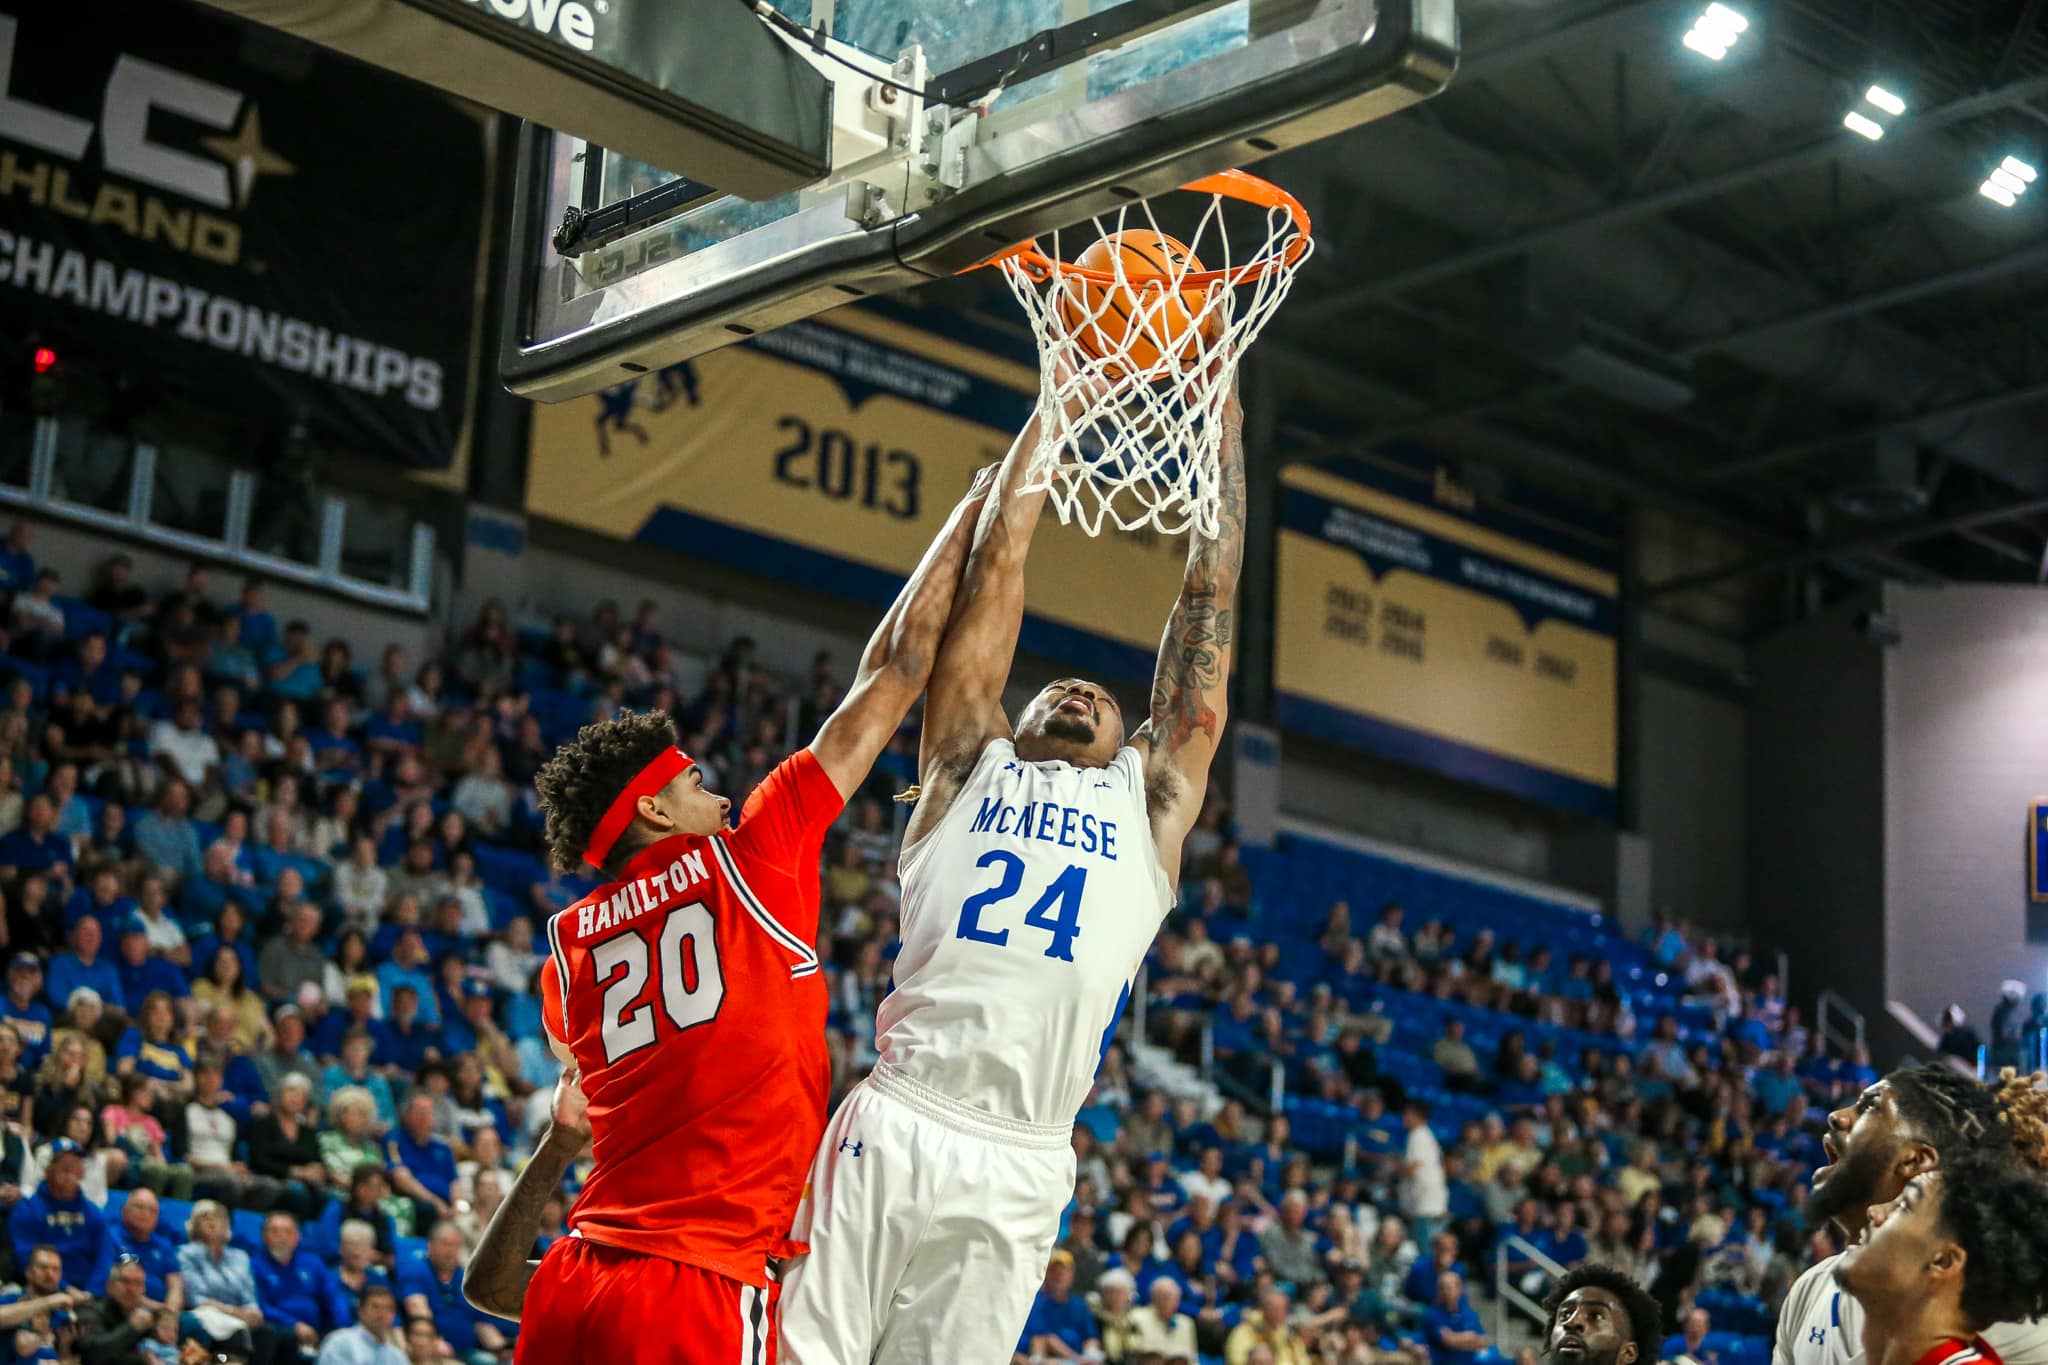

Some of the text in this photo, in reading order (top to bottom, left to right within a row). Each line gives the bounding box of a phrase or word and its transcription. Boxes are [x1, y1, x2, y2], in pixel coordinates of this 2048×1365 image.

[773, 415, 922, 521] 2013
[577, 848, 710, 939] HAMILTON
[956, 849, 1087, 962] 24
[590, 900, 728, 1067] 20
